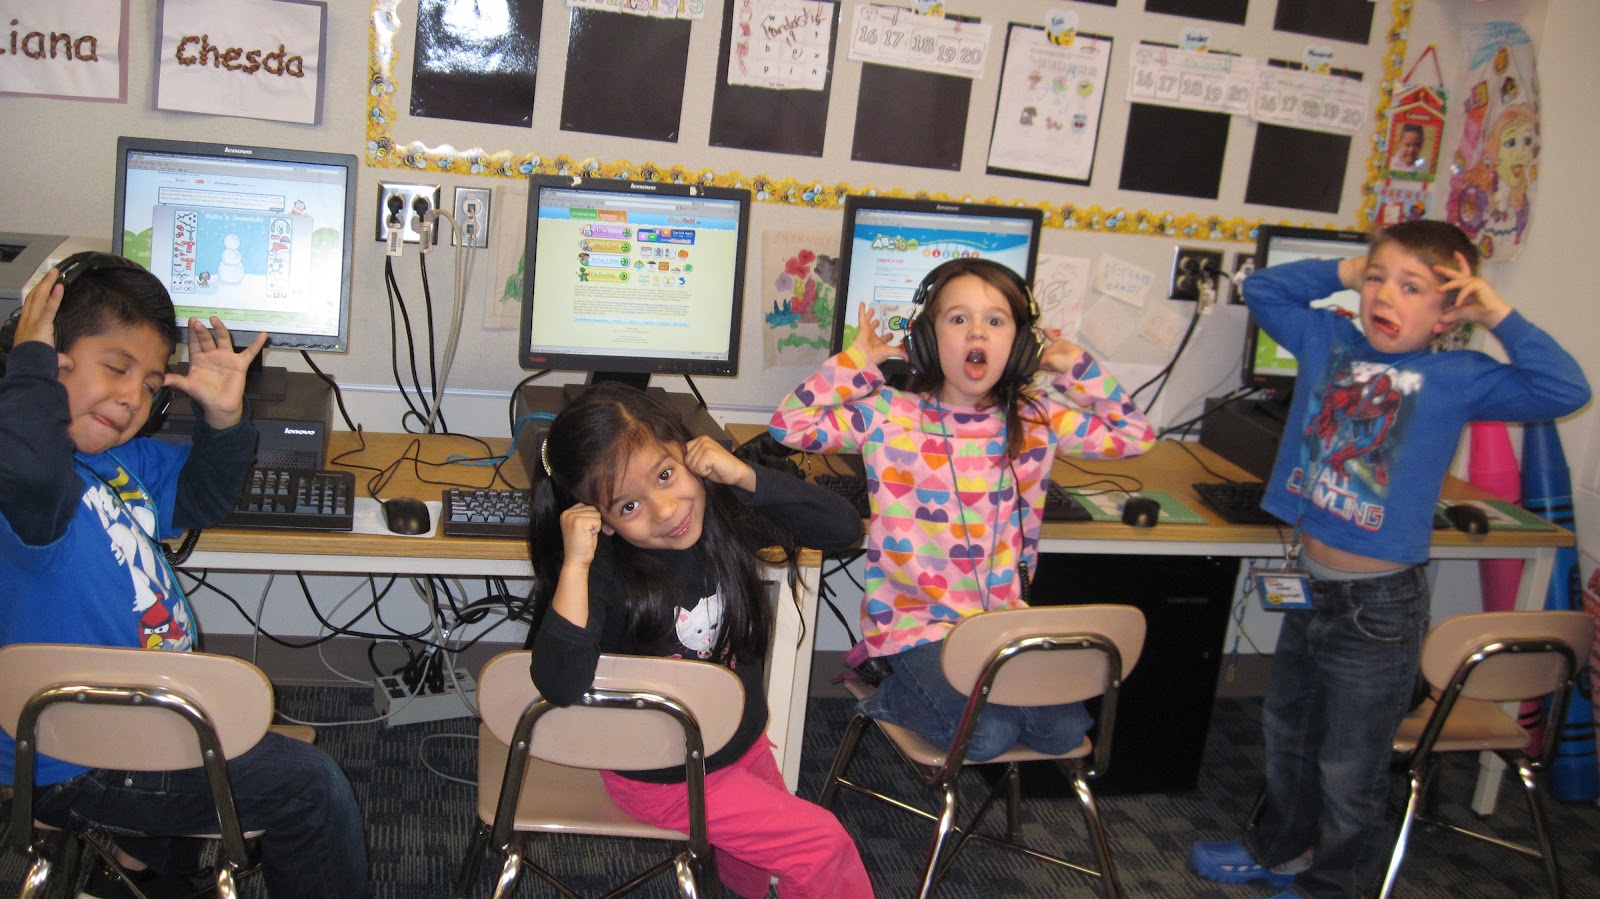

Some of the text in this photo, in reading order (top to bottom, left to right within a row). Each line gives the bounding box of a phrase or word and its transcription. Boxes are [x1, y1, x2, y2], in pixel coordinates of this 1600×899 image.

[0, 19, 98, 62] iana
[176, 34, 304, 78] Chesda
[860, 26, 982, 64] 16 17 18 19 20
[1137, 70, 1249, 102] 16 17 18 19 20
[1260, 94, 1276, 112] 16
[1281, 95, 1298, 112] 17
[1322, 102, 1340, 119] 19
[1342, 108, 1361, 125] 20
[225, 147, 252, 155] lenovo
[204, 212, 223, 220] Make
[284, 427, 315, 435] lenovo
[1287, 467, 1384, 531] CWLING
